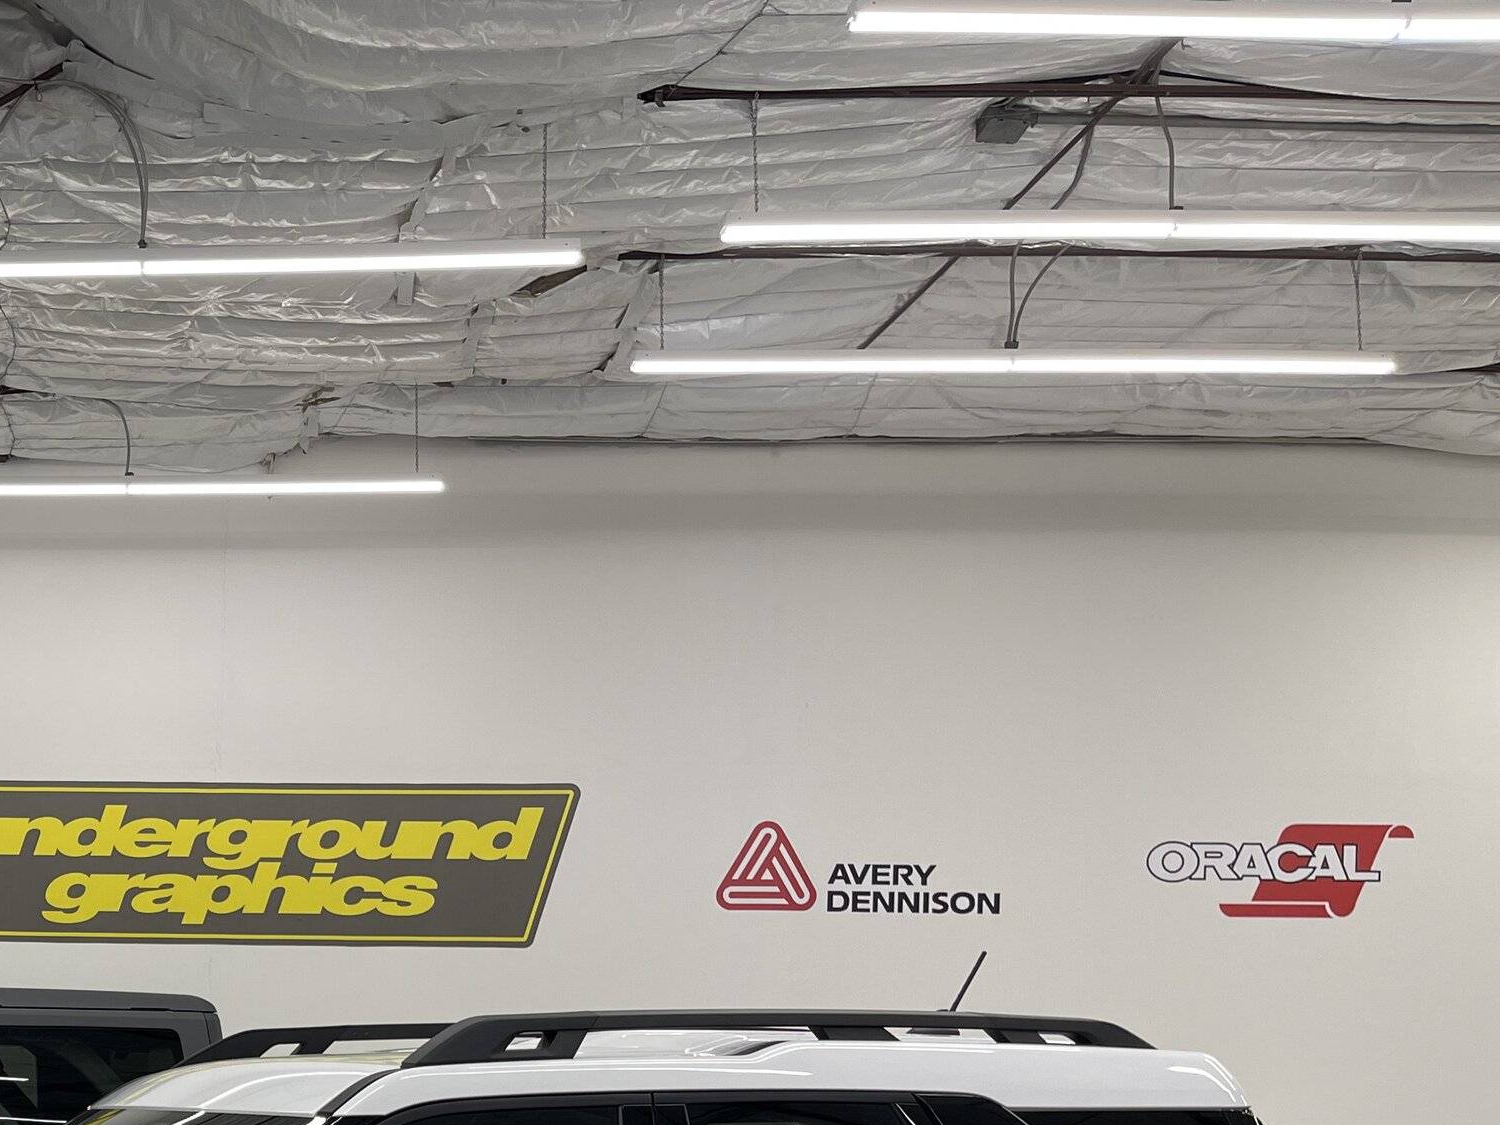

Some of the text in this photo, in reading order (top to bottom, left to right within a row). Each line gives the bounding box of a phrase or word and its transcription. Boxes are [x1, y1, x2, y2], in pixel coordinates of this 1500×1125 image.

[827, 863, 937, 886] AVERY
[1147, 841, 1381, 885] ORACAL
[41, 862, 438, 925] graphics
[826, 890, 1001, 914] DENNISON
